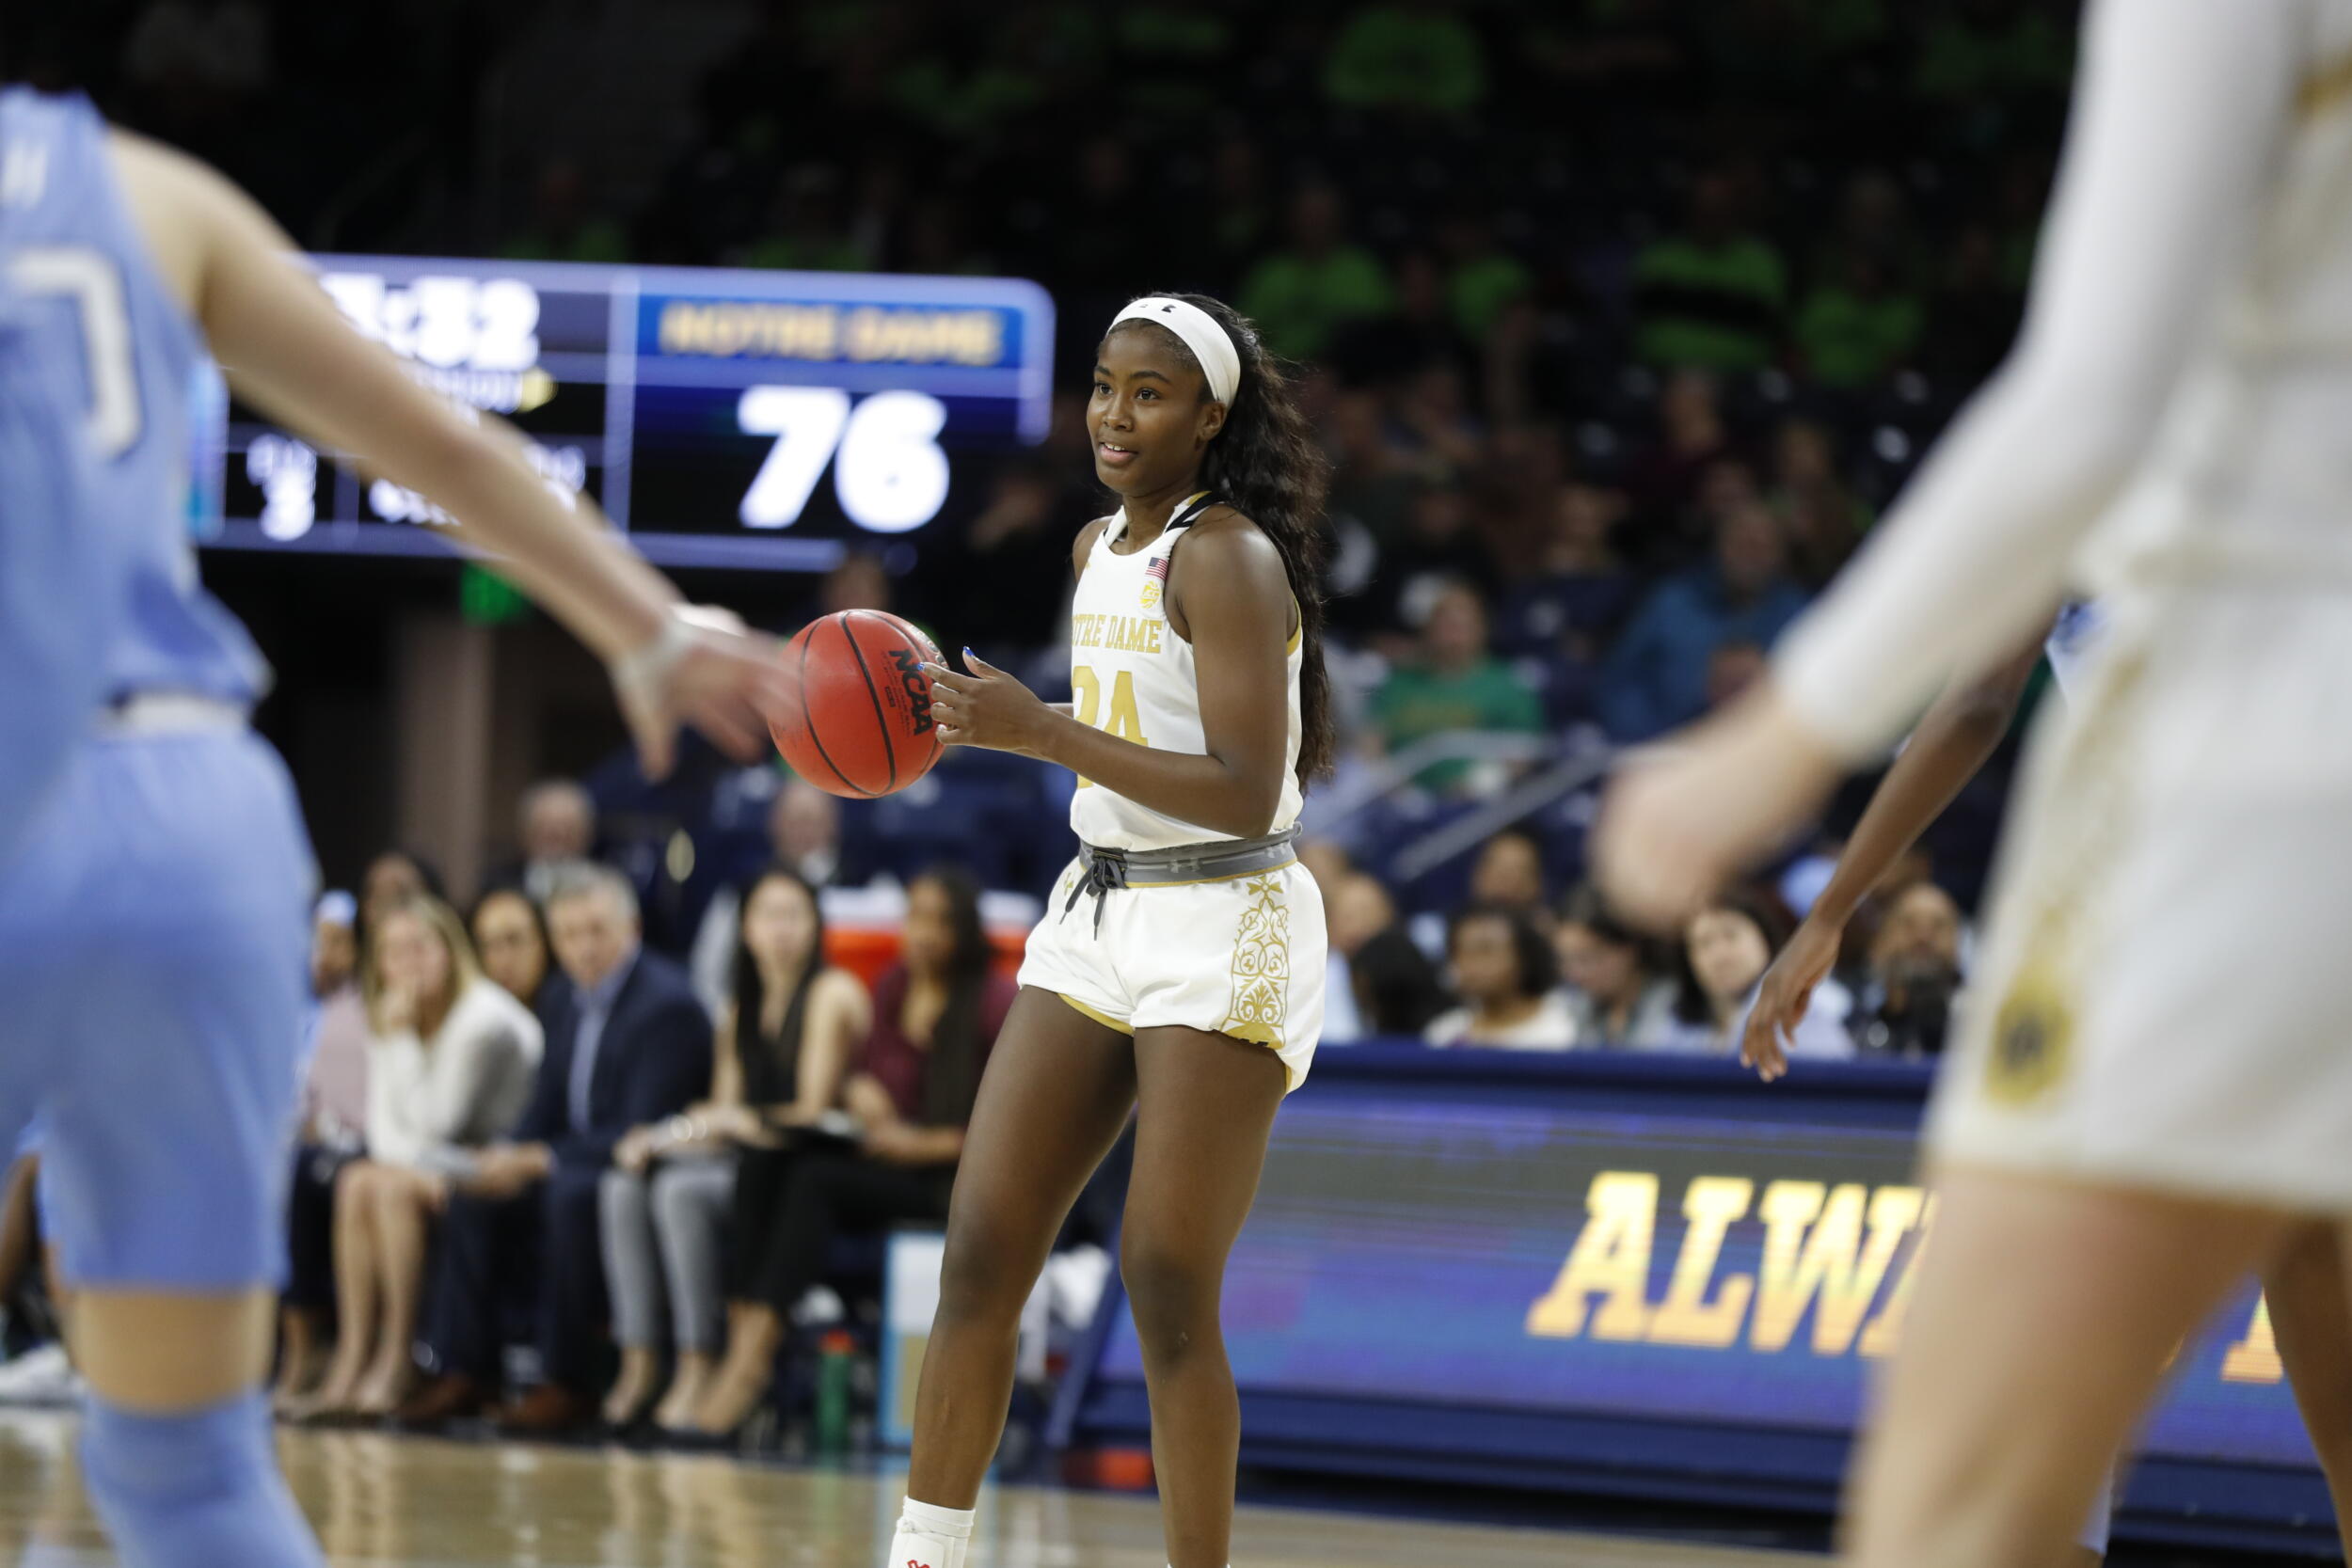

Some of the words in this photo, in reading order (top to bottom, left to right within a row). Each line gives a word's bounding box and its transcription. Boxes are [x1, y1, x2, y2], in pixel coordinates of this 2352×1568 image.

[737, 384, 949, 533] 76
[1104, 615, 1163, 654] DAME
[889, 648, 934, 736] NCAA
